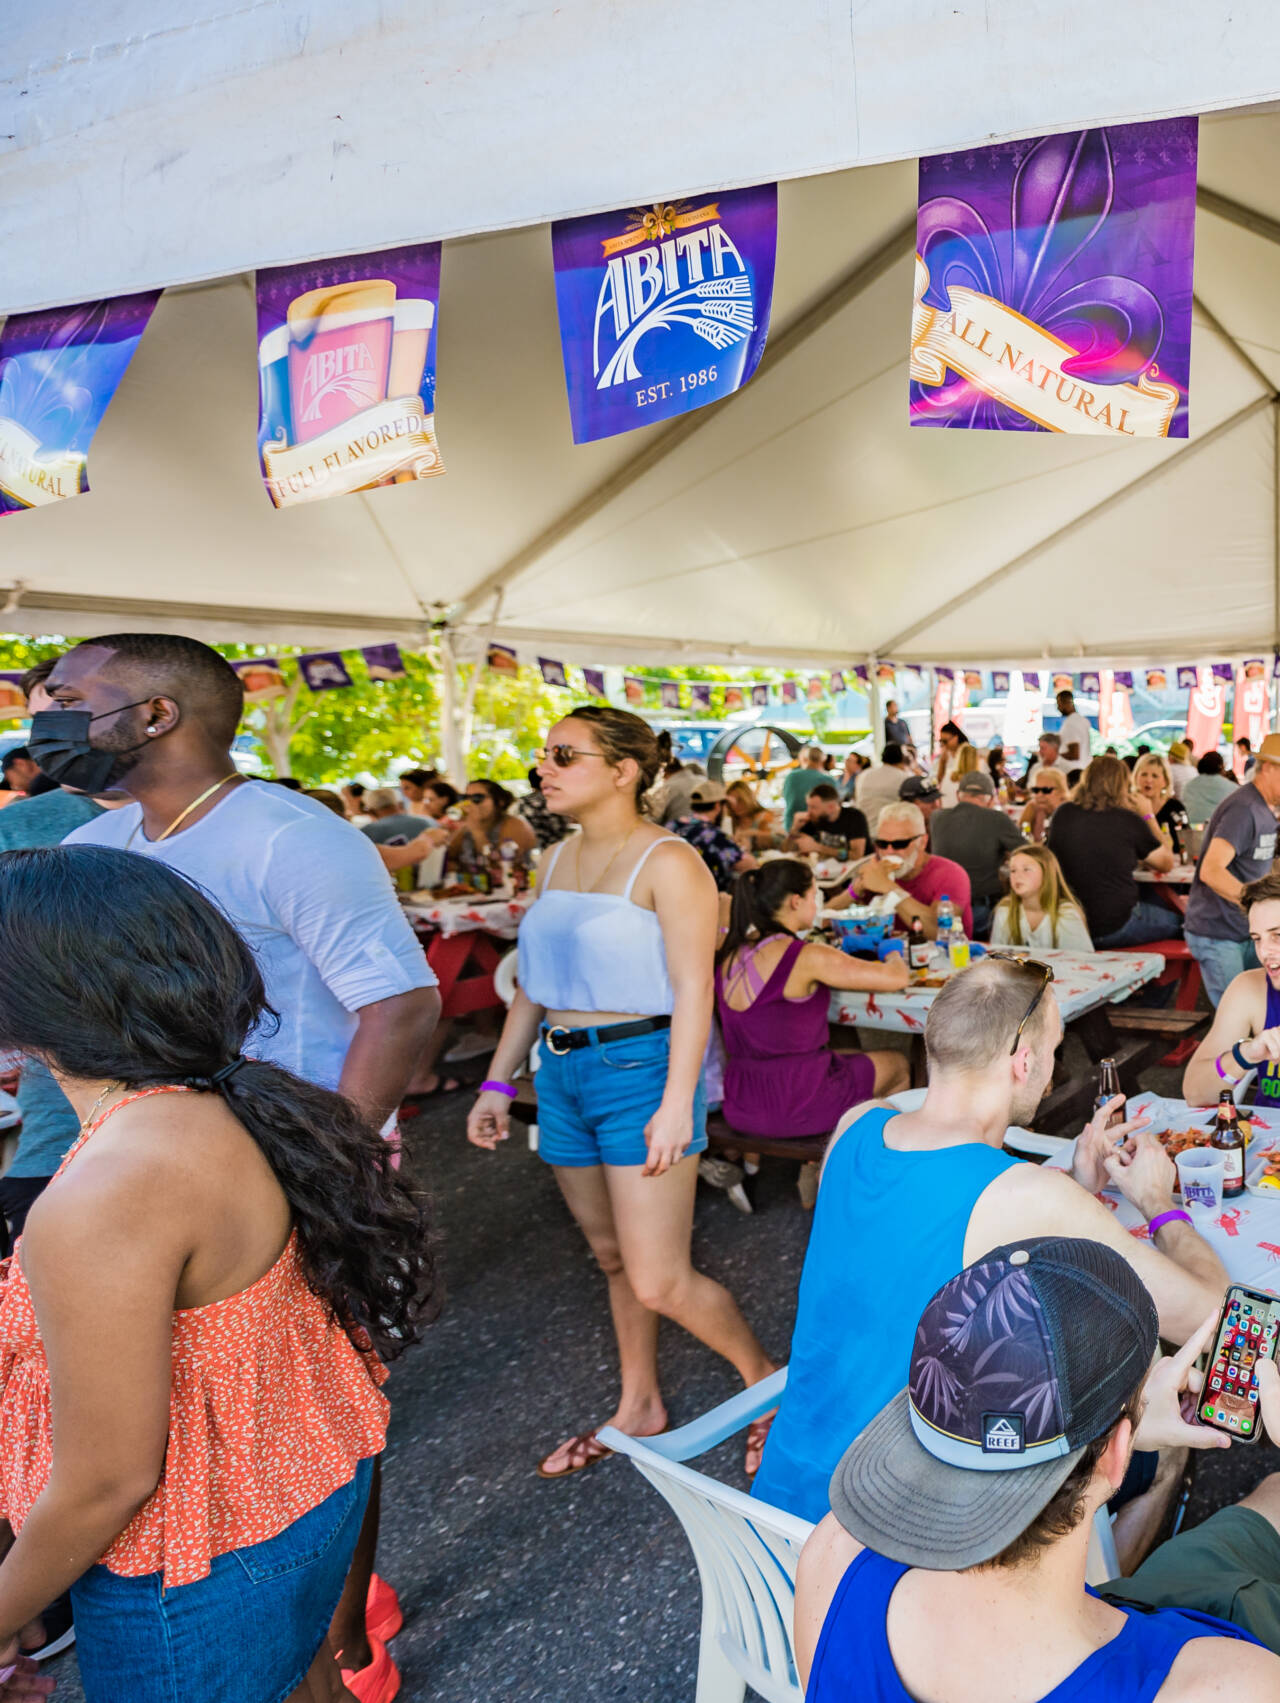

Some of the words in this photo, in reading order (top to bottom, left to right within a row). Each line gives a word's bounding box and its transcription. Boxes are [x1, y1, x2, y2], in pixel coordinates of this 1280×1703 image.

[594, 224, 745, 378] ABITA
[301, 342, 376, 416] ABITA
[636, 383, 673, 407] EST.
[680, 365, 718, 393] 1986
[939, 311, 994, 358] ALL
[997, 342, 1136, 437] NATURAL
[322, 414, 420, 470] FLAVORED
[988, 1437, 1017, 1448] REEF
